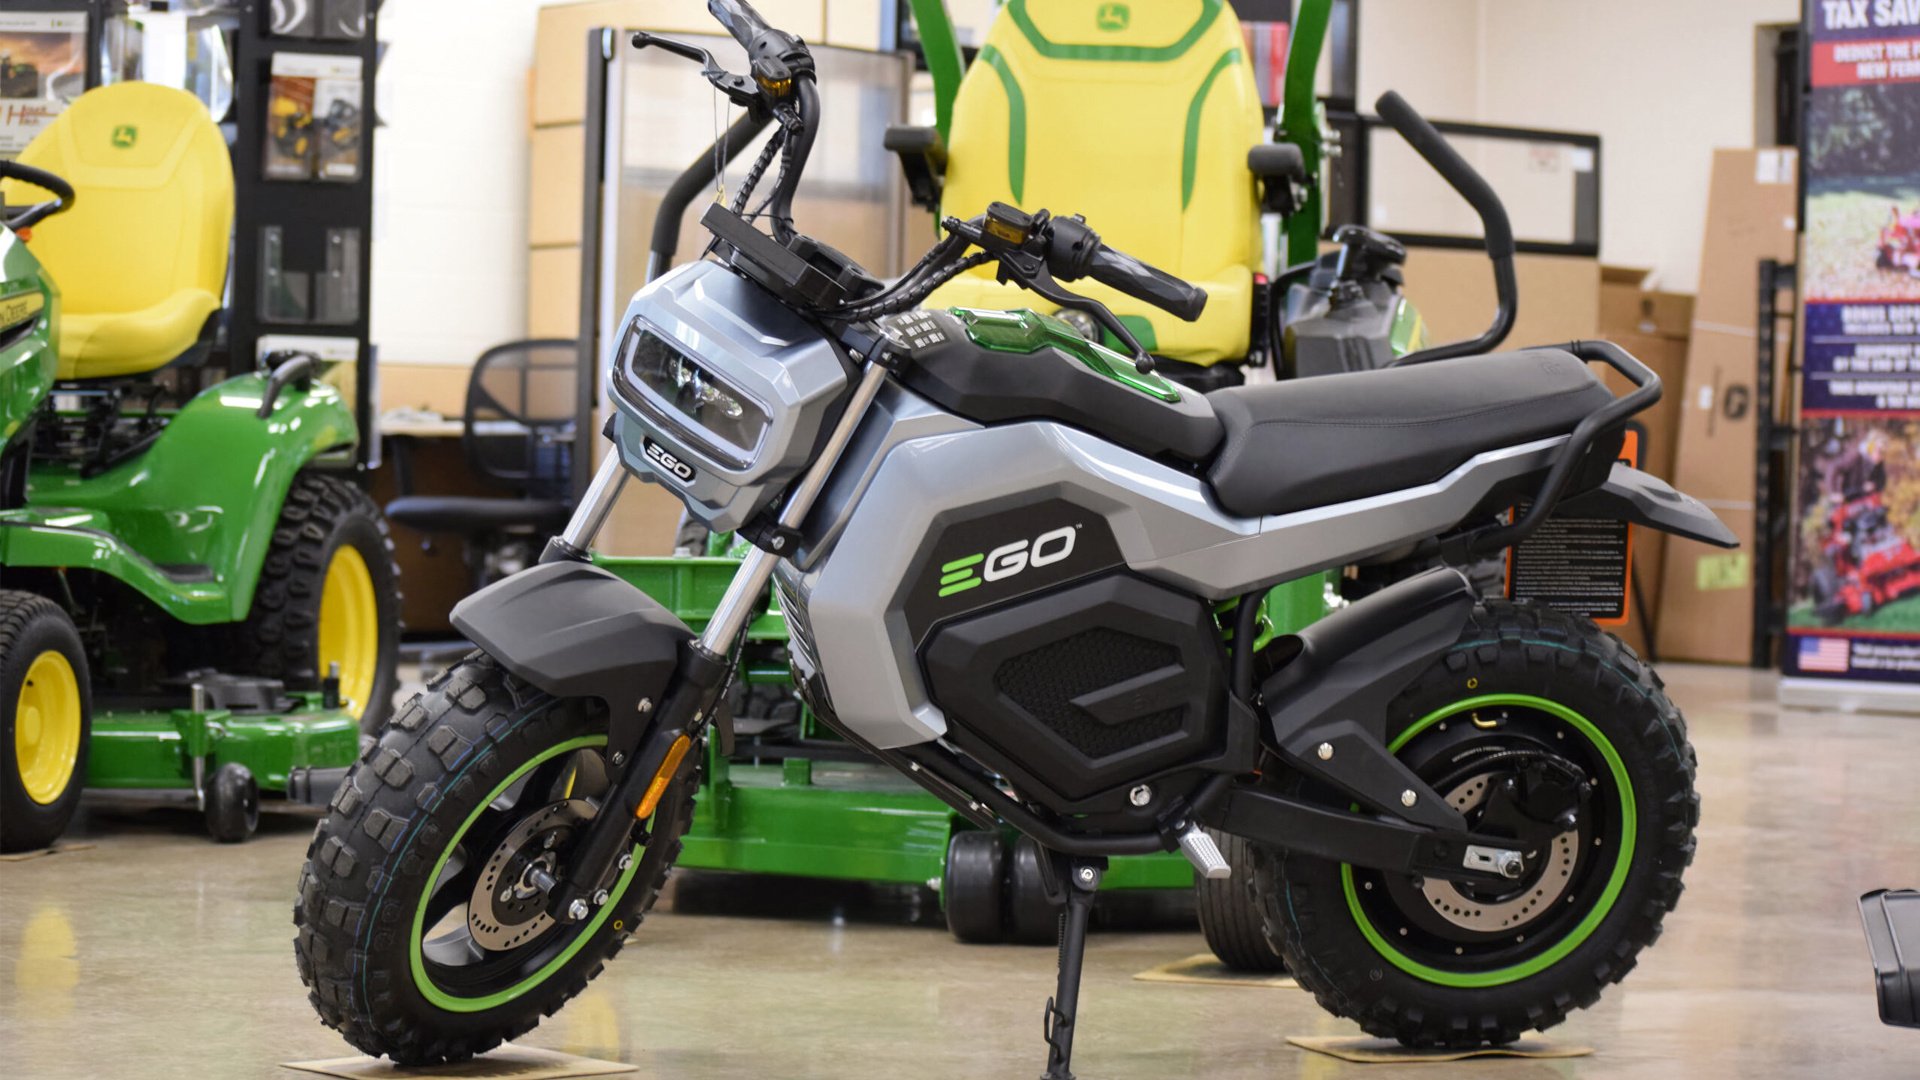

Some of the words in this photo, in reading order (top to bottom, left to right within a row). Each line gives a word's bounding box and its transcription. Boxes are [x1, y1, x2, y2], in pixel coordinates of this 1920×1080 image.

[1822, 0, 1869, 30] TAX
[646, 443, 692, 479] EGO
[938, 525, 1076, 597] EGO
